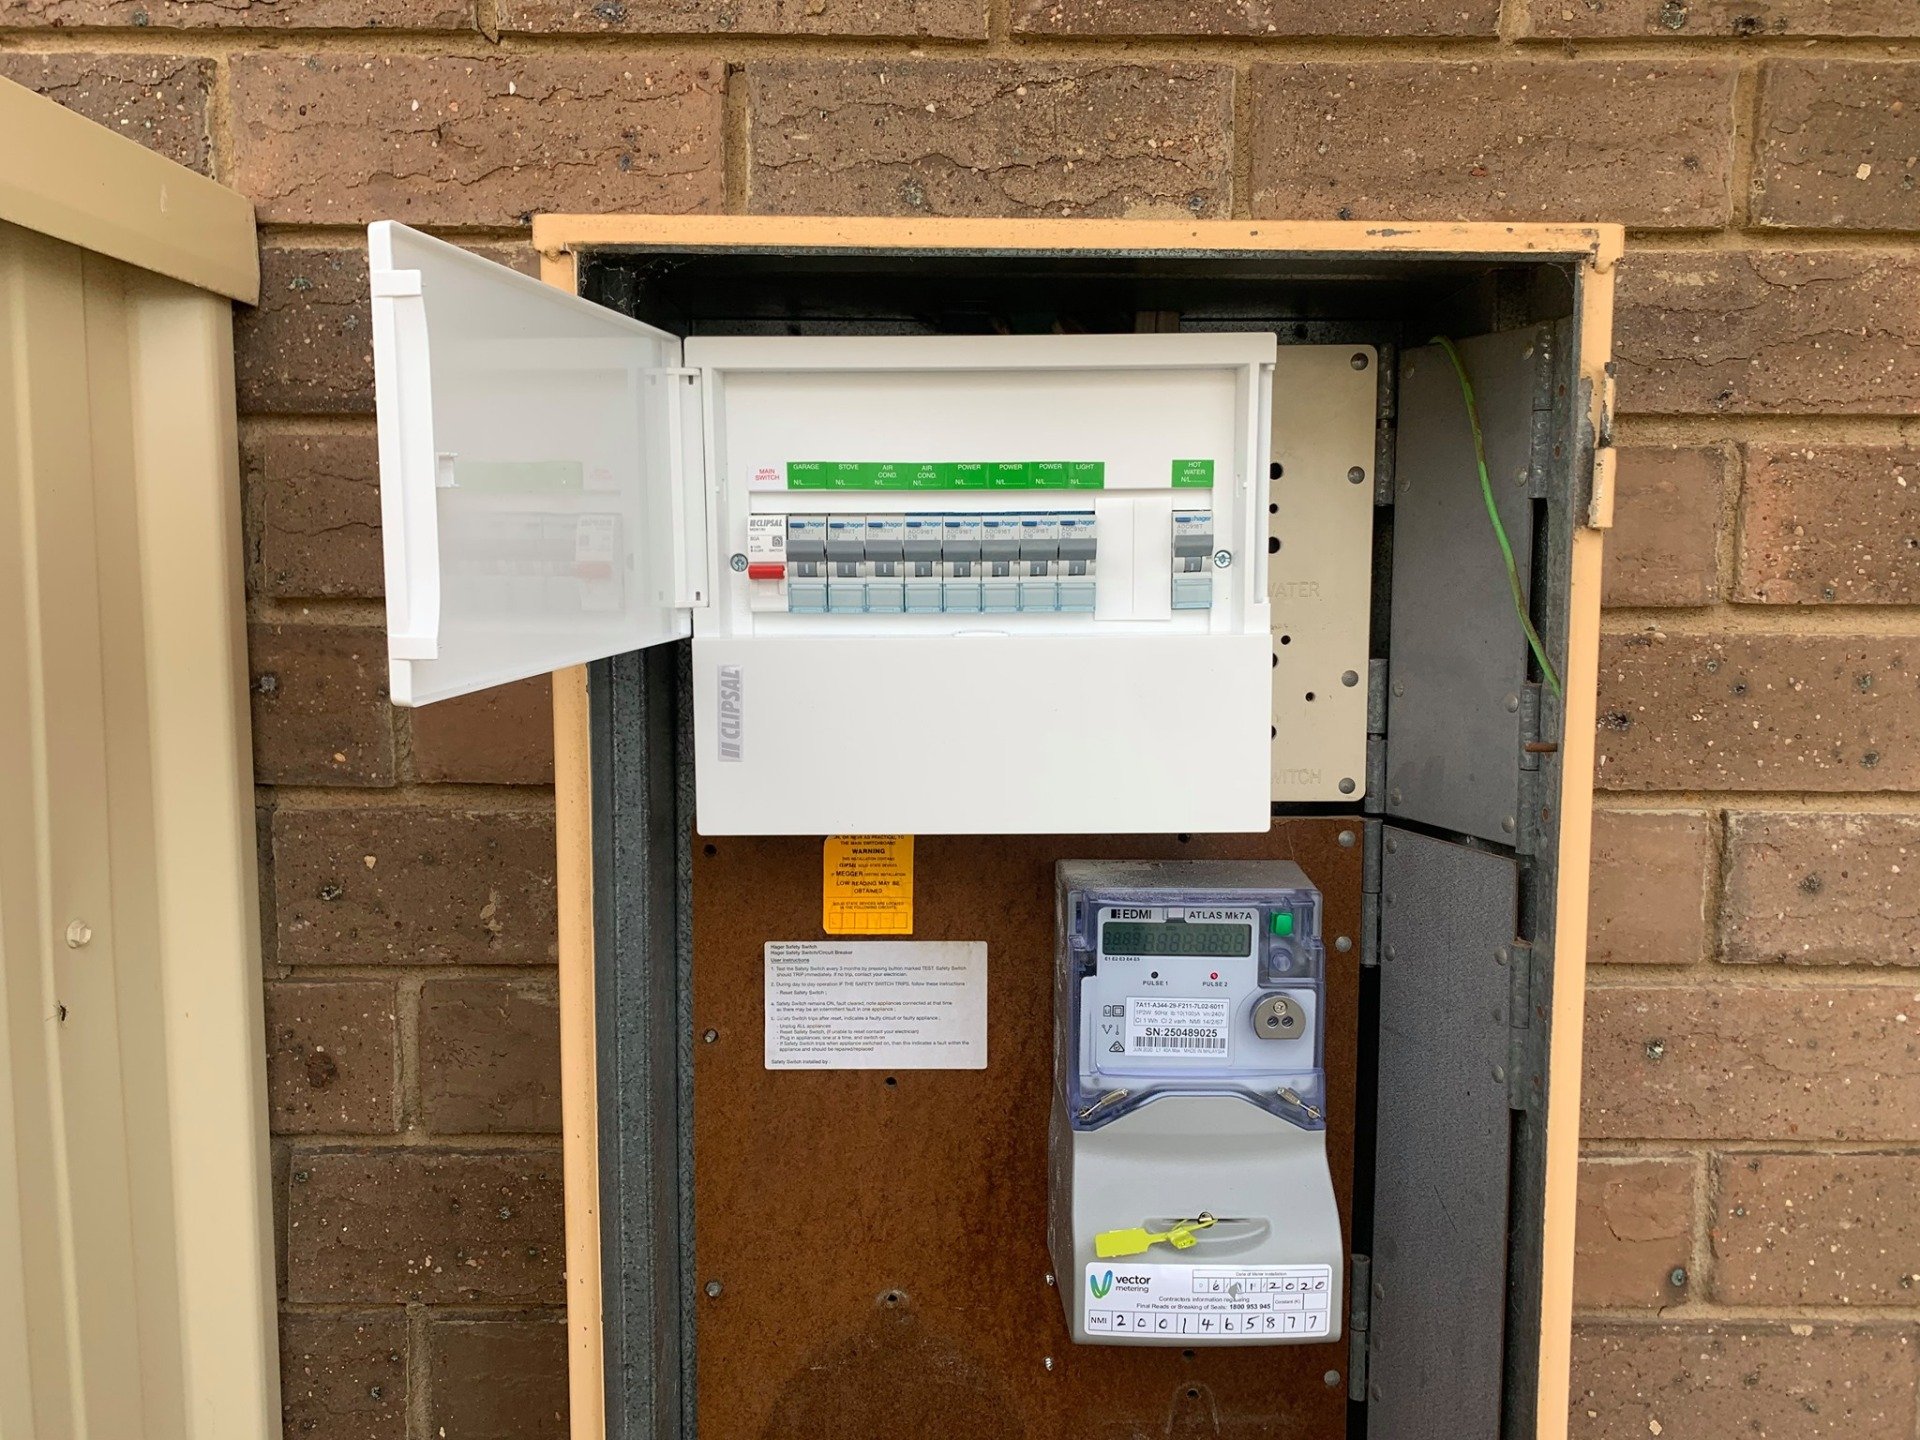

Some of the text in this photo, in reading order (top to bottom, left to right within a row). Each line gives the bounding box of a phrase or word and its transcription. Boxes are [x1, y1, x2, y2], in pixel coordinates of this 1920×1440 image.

[721, 670, 740, 739] CLIPSAL
[1271, 768, 1322, 785] WITCH
[1123, 909, 1151, 919] EDMI
[1189, 911, 1252, 920] ATLAS Mk7A
[1145, 1027, 1218, 1037] SN:250489025
[1116, 1275, 1151, 1285] vector
